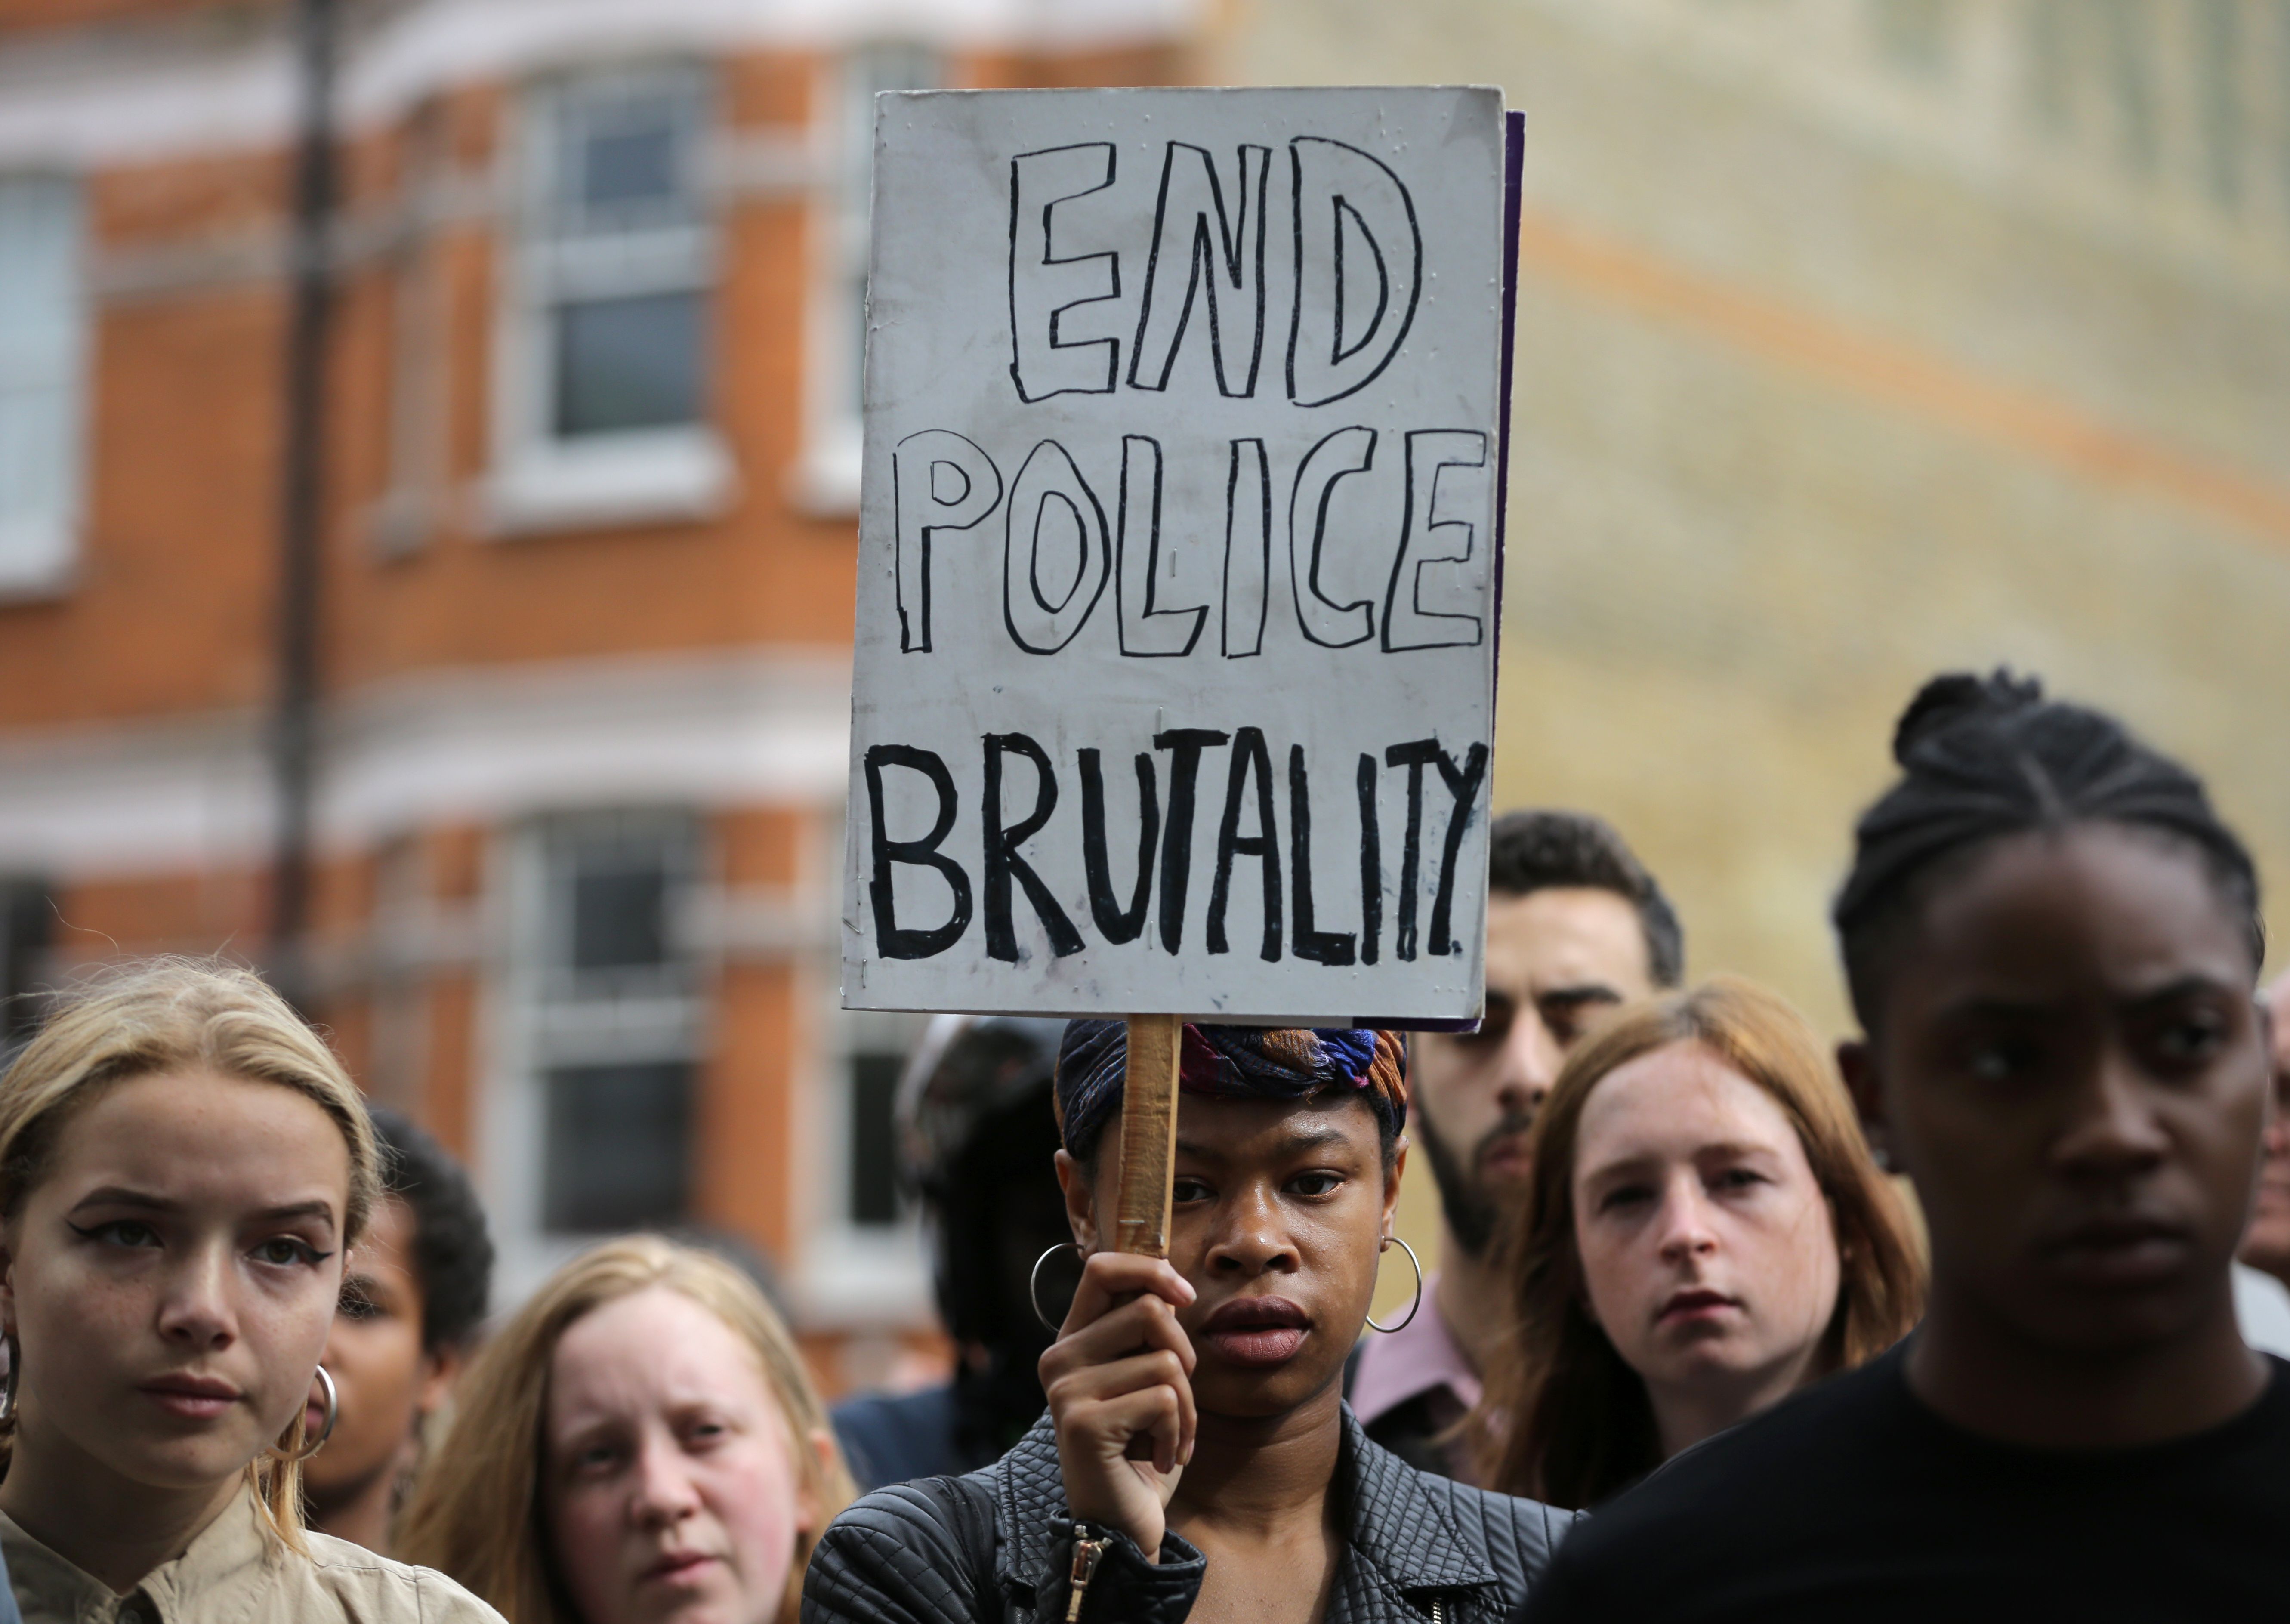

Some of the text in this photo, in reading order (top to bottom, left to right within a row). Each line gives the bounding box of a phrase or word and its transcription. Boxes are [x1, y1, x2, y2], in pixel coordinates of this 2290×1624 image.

[1009, 136, 1423, 407] END
[892, 425, 1487, 660] POLICE
[864, 726, 1488, 966] BRUTALITY
